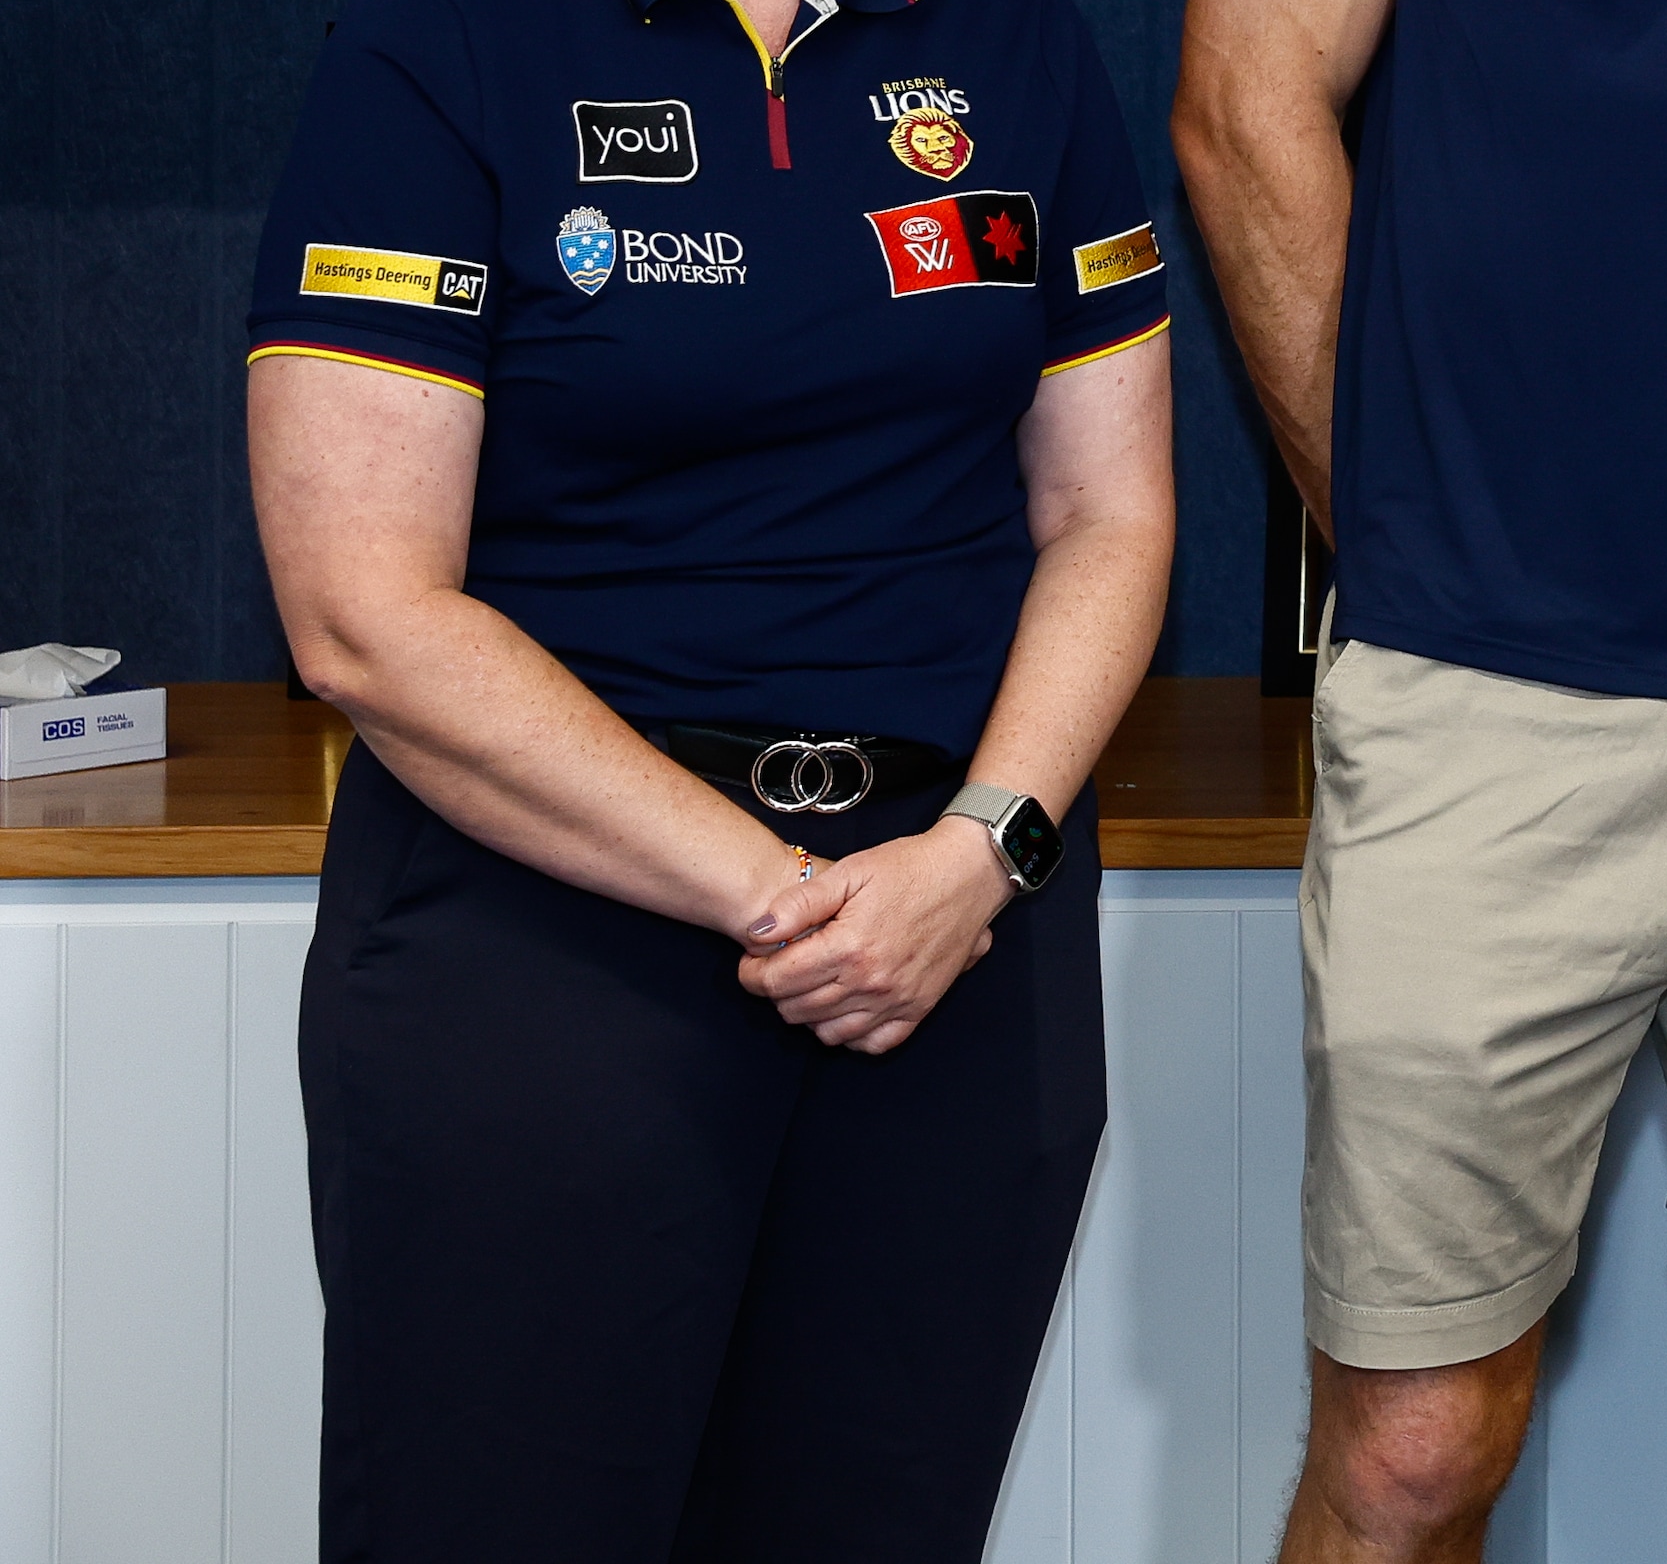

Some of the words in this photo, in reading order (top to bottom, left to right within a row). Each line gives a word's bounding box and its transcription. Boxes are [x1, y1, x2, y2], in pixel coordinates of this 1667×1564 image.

[882, 76, 947, 94] BRISBANE
[868, 88, 971, 122] LIONS
[592, 112, 680, 165] youi
[906, 222, 938, 236] AFL
[622, 229, 744, 265] BOND
[1087, 249, 1132, 273] Hastings
[315, 261, 372, 282] Hastings
[375, 267, 432, 290] Deering
[626, 262, 748, 285] UNIVERSITY
[442, 271, 483, 300] CAT
[44, 720, 85, 740] COS
[97, 713, 128, 725] FACIAL
[97, 720, 135, 733] TISSUES
